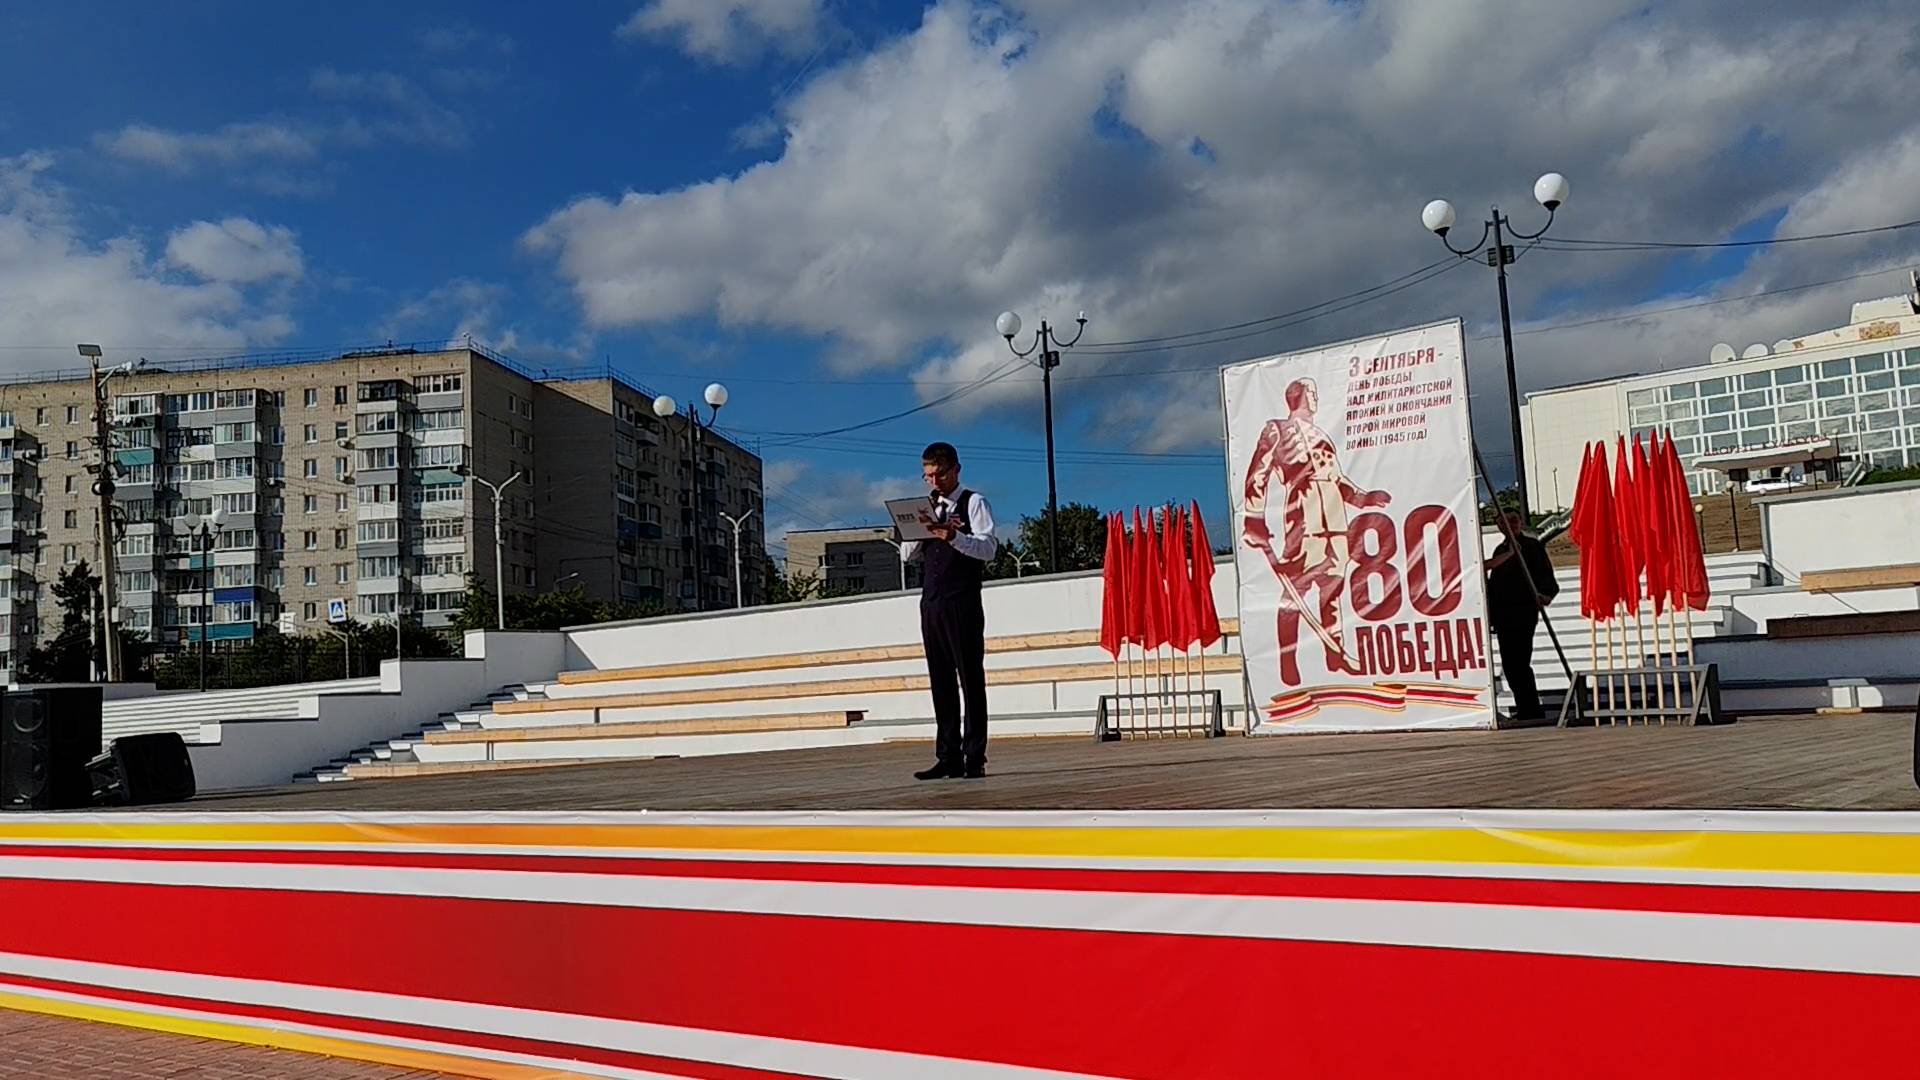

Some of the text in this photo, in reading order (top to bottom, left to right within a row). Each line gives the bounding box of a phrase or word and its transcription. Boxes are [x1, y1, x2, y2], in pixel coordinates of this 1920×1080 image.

[1349, 356, 1360, 377] 3
[1364, 346, 1435, 374] СЕНТЯБРЯ
[1346, 377, 1452, 407] НАД МИЛИТАРИСТСКОЙ
[1348, 371, 1412, 394] ДЕНЬ ПОБЕДЫ
[1346, 394, 1452, 421] ЯПОНИЕЙ И ОКОНЧАНИЯ
[1346, 412, 1426, 436] ВТОРОЙ МИРОВОЙ
[1346, 436, 1378, 451] ВОЙНЫ
[1379, 431, 1406, 446] (1945
[1348, 505, 1462, 621] 80
[1355, 617, 1487, 680] ПОБЕДА!
